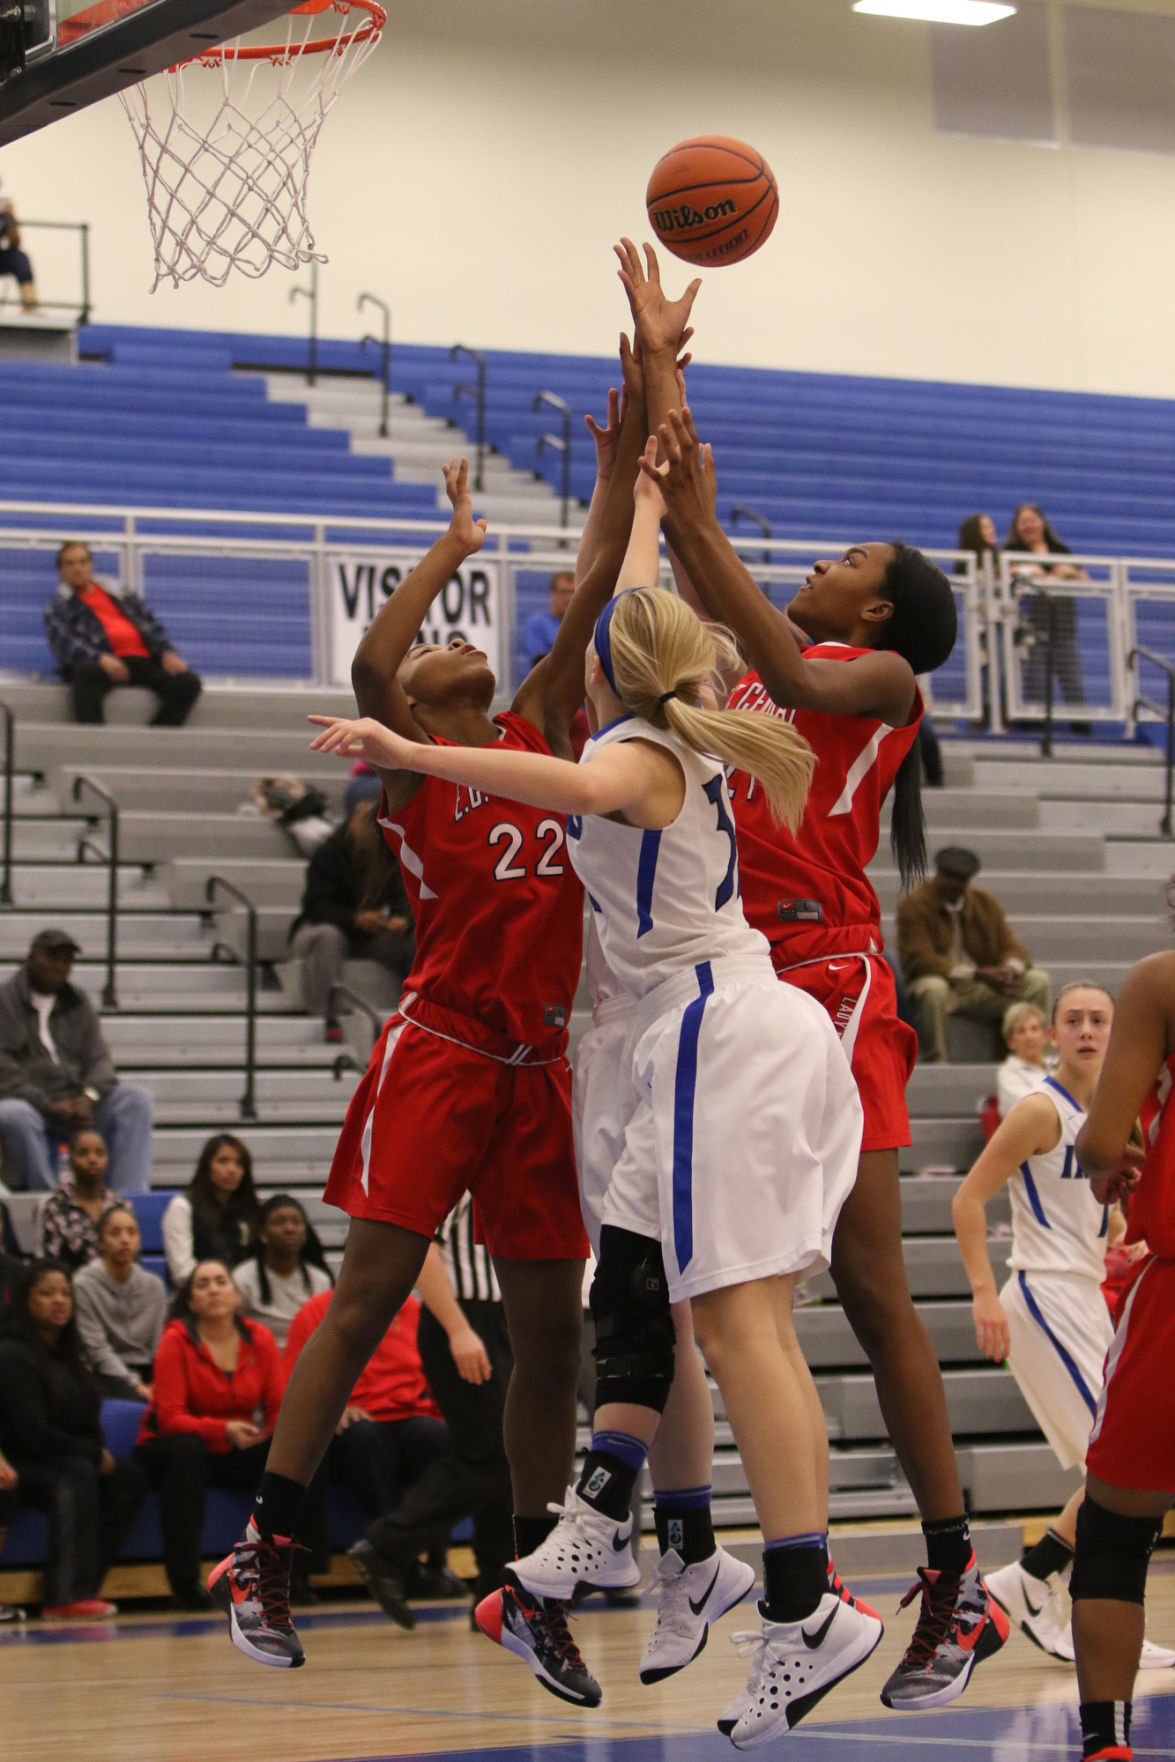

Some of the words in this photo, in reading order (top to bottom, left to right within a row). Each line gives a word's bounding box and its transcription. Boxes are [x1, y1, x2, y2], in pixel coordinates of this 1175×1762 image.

[653, 198, 737, 232] Wilson
[338, 563, 492, 627] VISOR
[488, 818, 565, 882] 22
